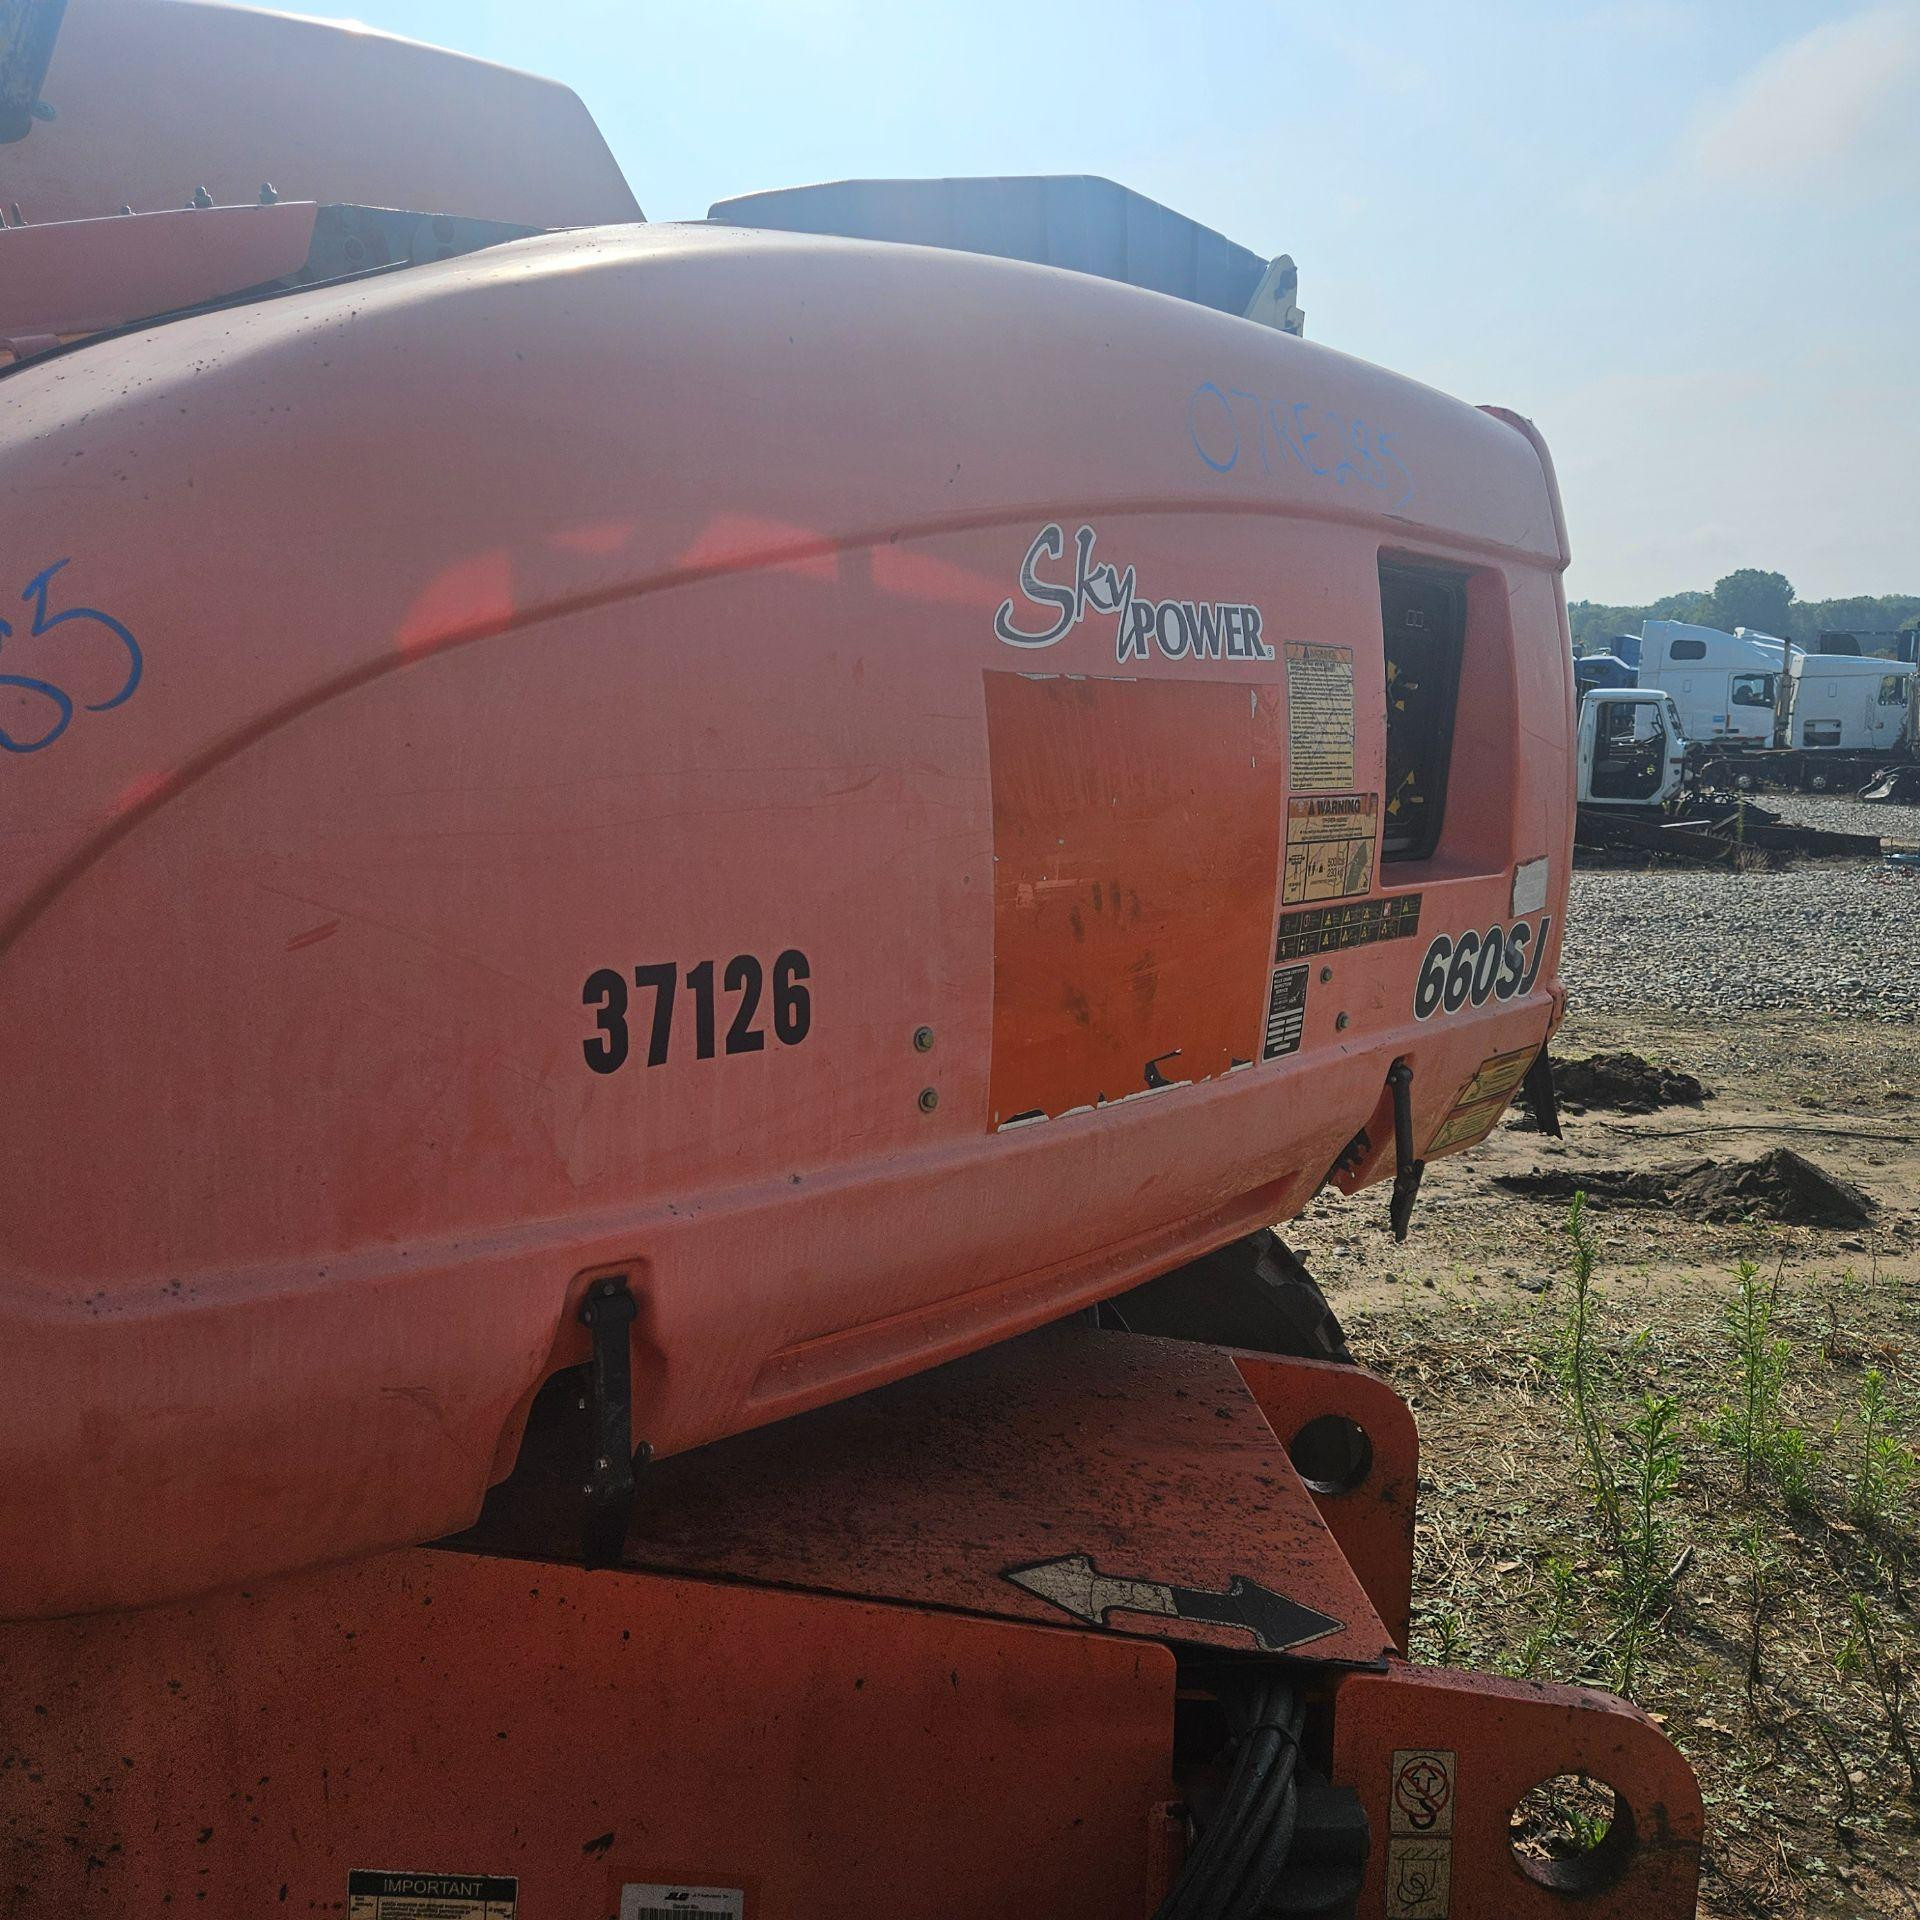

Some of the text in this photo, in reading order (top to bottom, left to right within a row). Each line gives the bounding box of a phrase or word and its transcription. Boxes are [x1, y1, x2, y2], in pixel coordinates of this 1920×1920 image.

[995, 524, 1135, 663] Sky
[1130, 600, 1267, 659] POWER
[1317, 798, 1361, 815] WARNING
[1414, 915, 1551, 1021] 660SJ
[583, 949, 811, 1075] 37126
[383, 1878, 483, 1897] IMPORTANT
